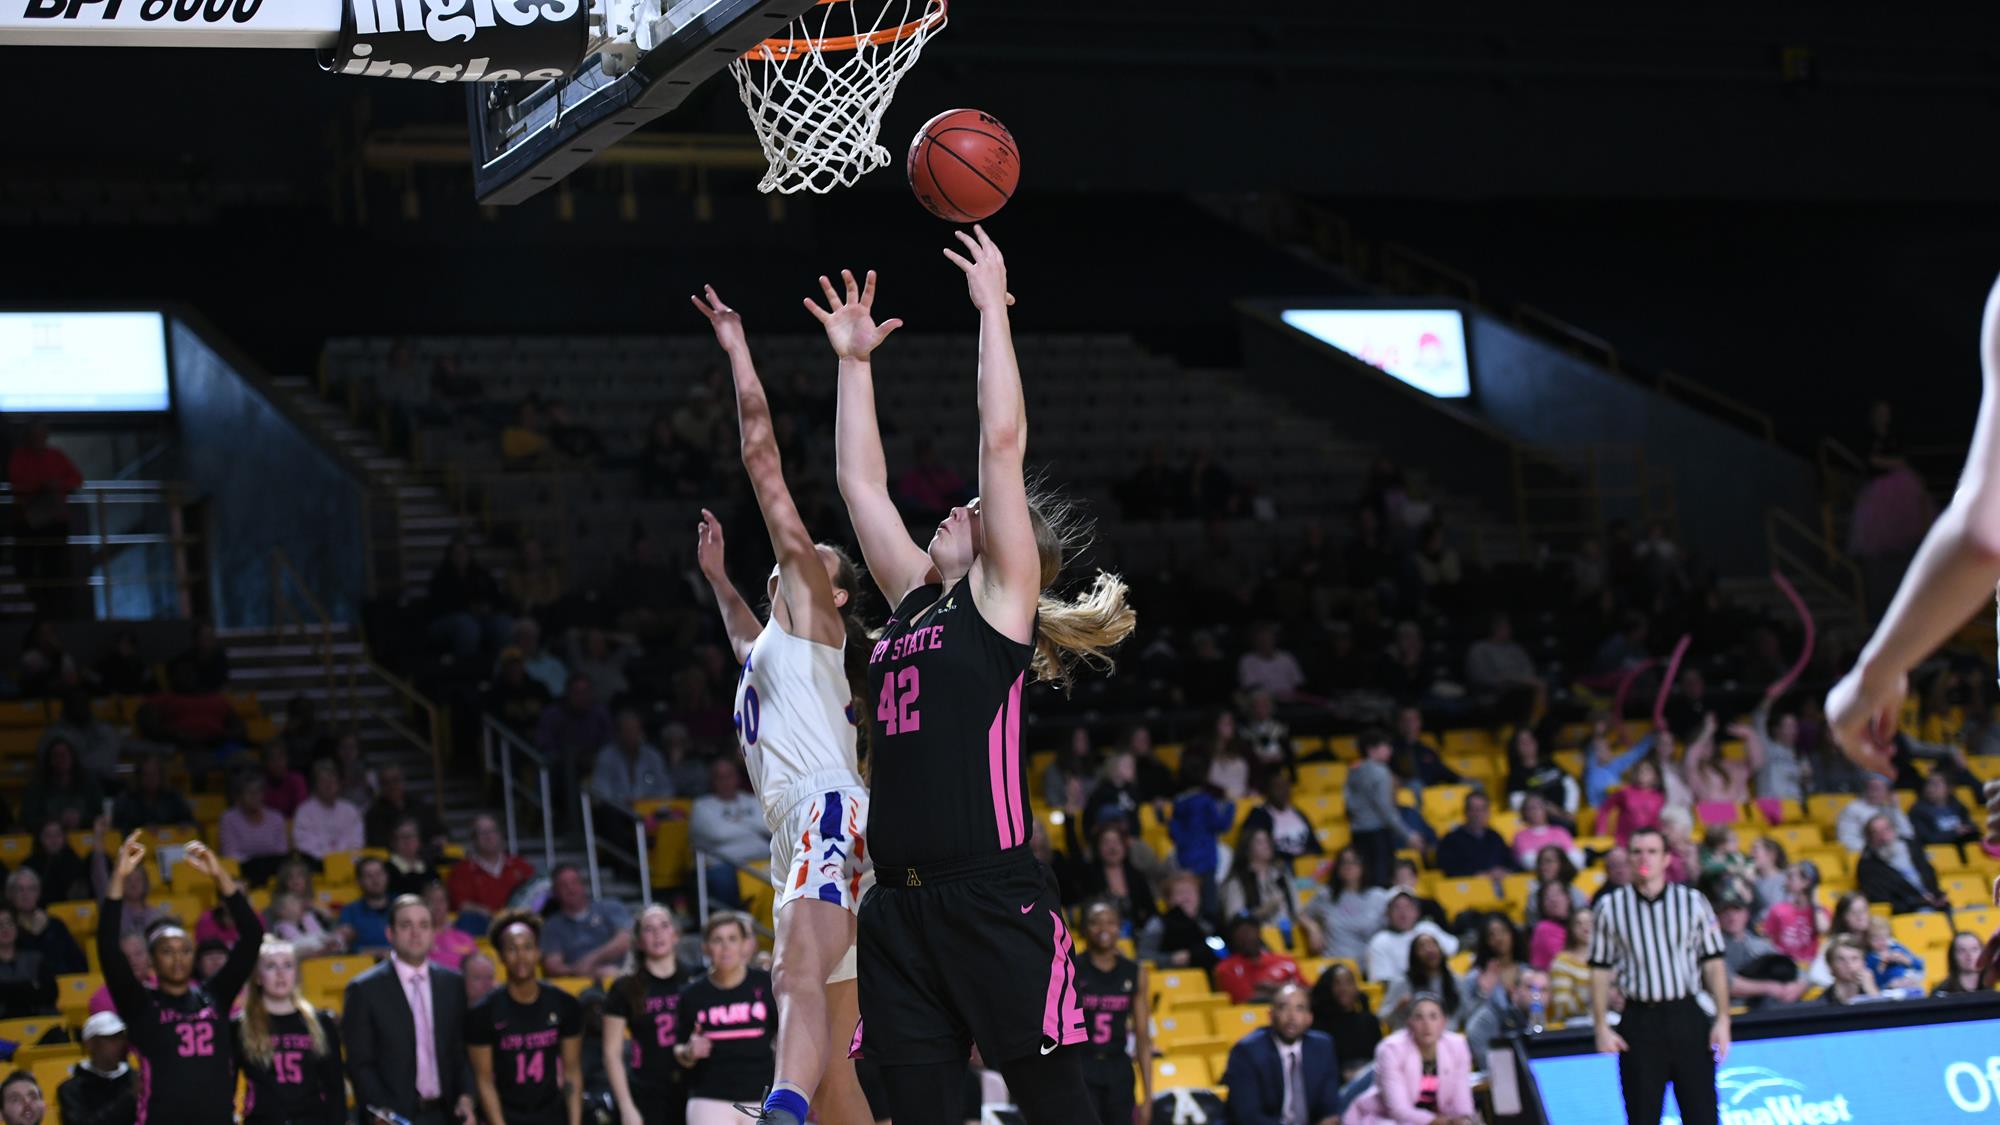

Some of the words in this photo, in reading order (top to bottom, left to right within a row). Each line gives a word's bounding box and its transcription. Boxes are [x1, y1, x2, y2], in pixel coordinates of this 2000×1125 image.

[891, 625, 944, 661] STATE
[877, 665, 920, 736] 42
[176, 1022, 214, 1057] 32
[1092, 1012, 1113, 1044] 5
[272, 1051, 304, 1084] 15
[515, 1049, 545, 1085] 14
